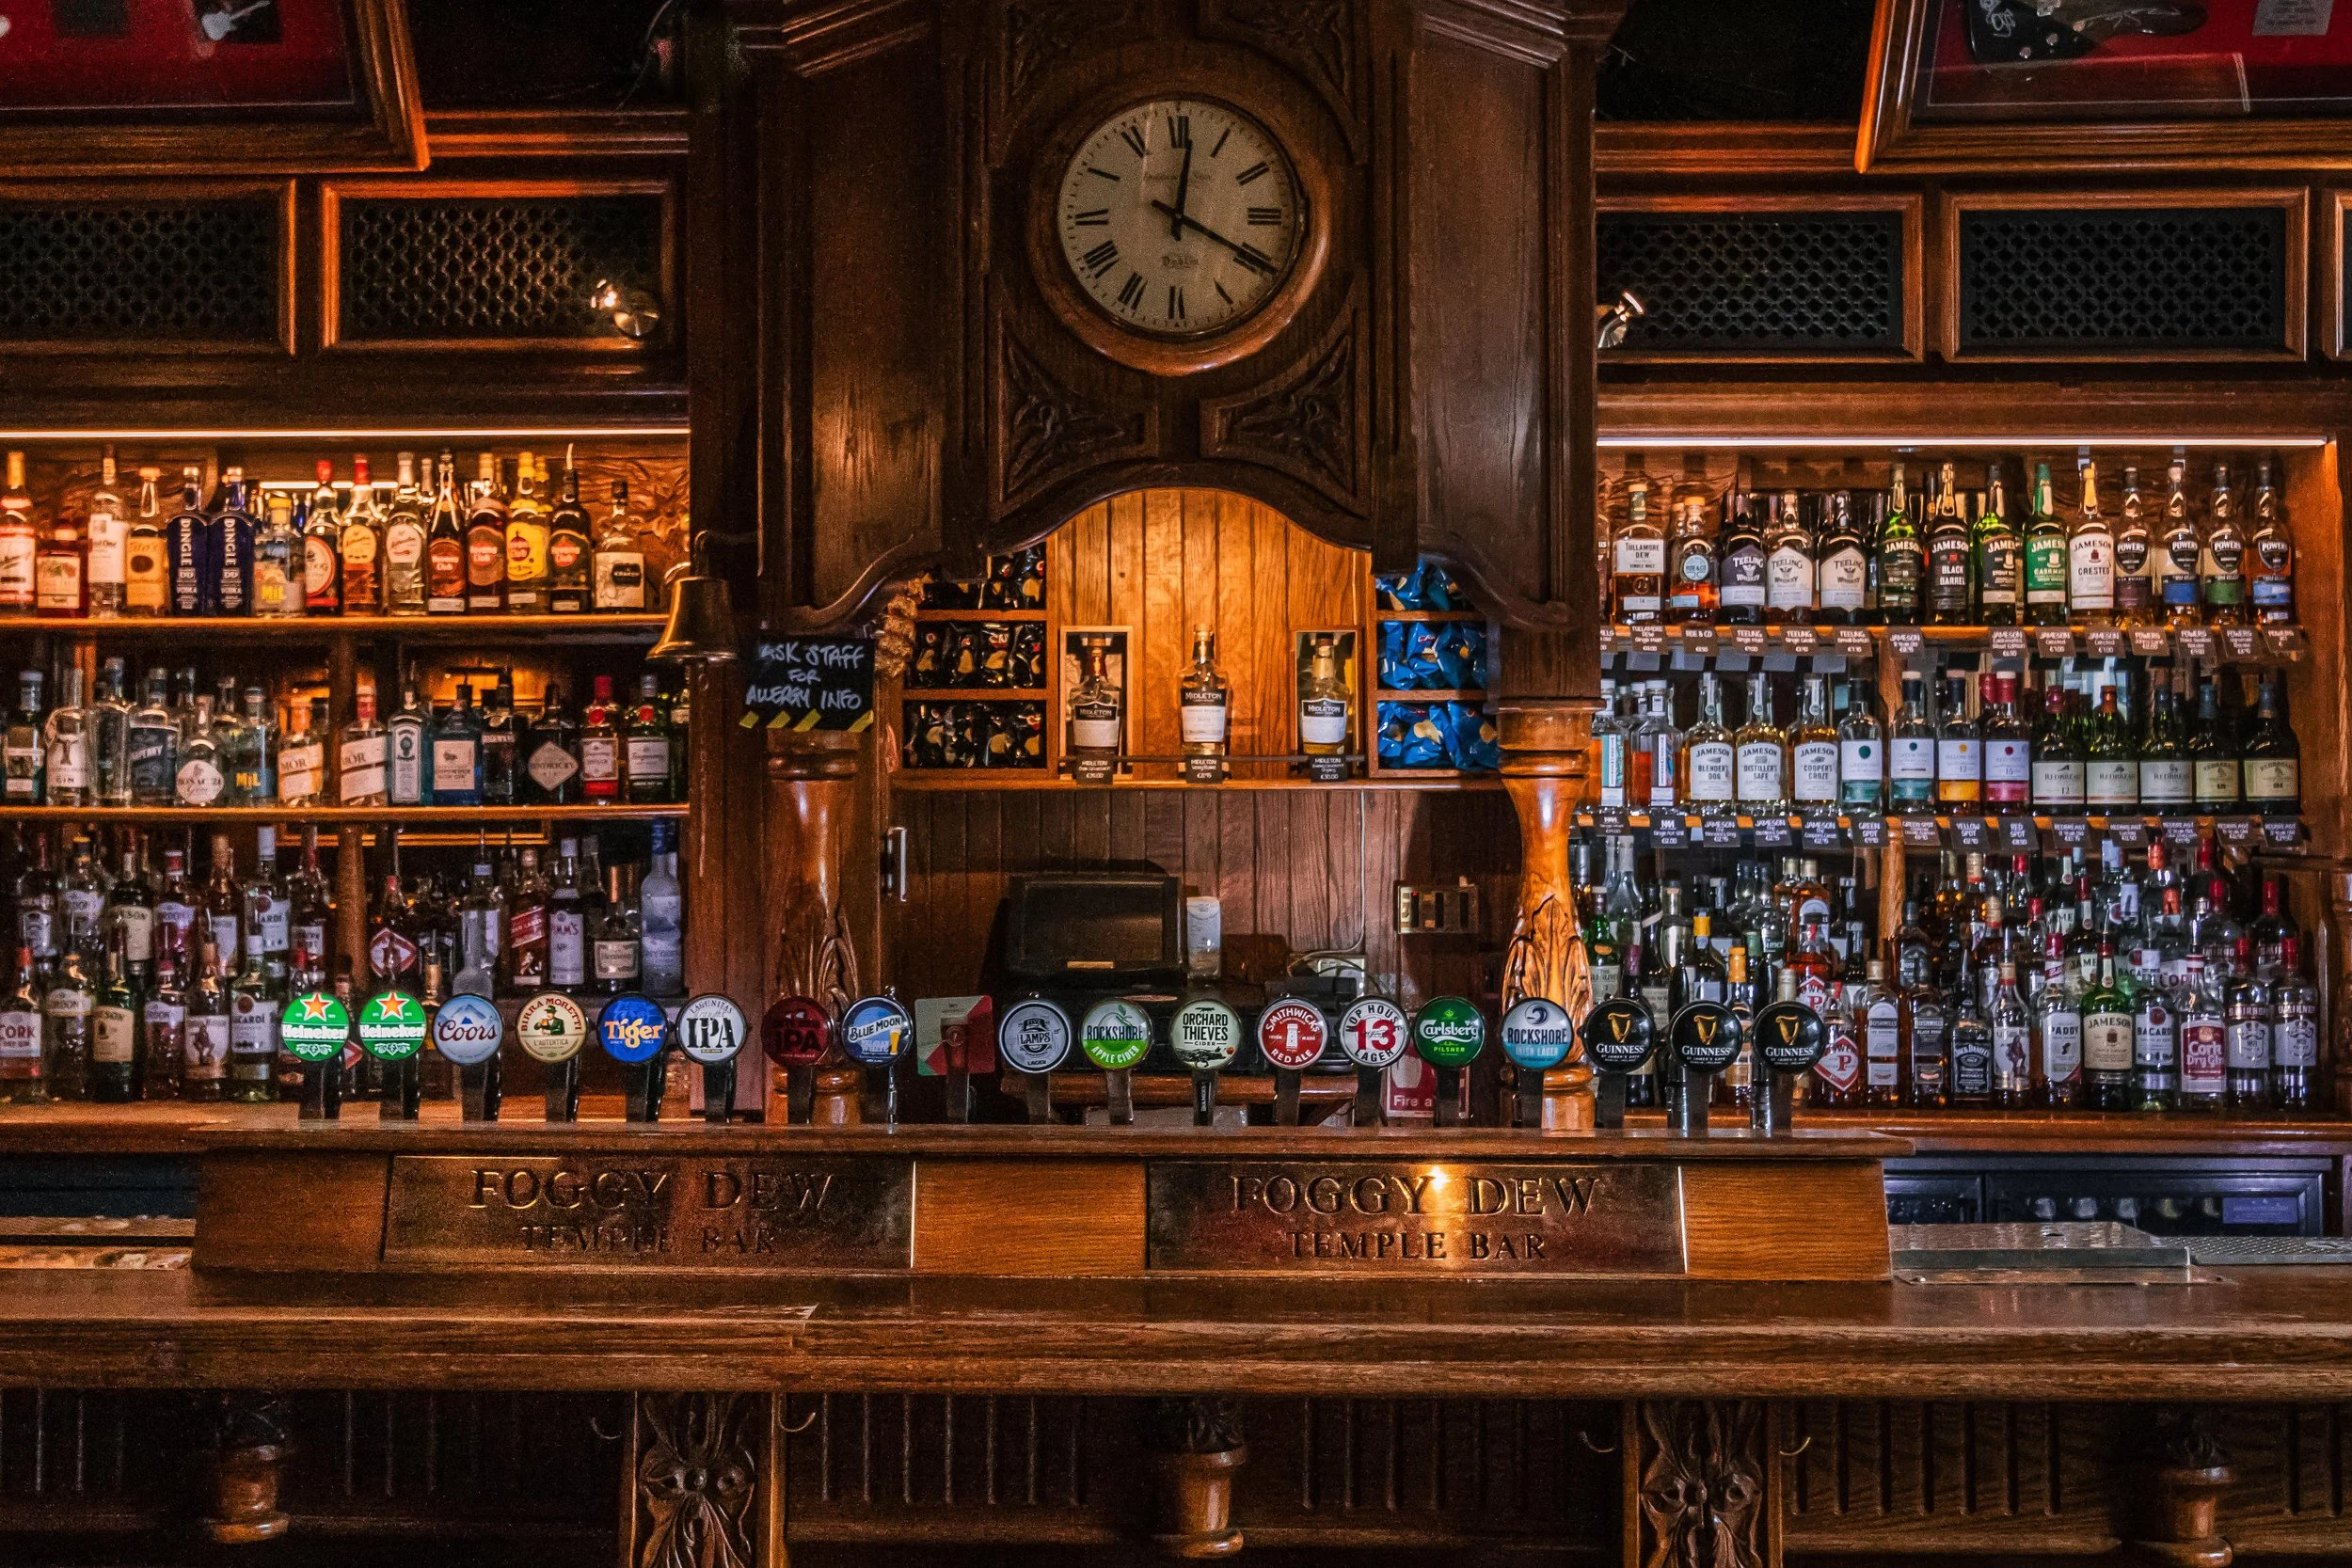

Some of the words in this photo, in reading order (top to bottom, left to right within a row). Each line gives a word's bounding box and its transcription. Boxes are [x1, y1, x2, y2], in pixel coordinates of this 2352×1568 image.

[181, 518, 192, 566] DINGLE
[224, 518, 236, 566] DINGLE
[1625, 543, 1660, 551] TULLAMORE
[2118, 543, 2145, 552] POWERS
[2215, 541, 2241, 550] POWERS
[2262, 542, 2288, 551] POWERS
[1733, 557, 1764, 568] TEELING
[1772, 560, 1803, 570] TEELING
[1834, 559, 1864, 570] TEELING
[759, 641, 799, 661] ASK
[805, 644, 865, 669] STAFF
[787, 670, 821, 683] FOR
[820, 690, 862, 709] INFO
[1185, 691, 1222, 700] MIDLETON
[1696, 747, 1730, 757] JAMESON
[1742, 748, 1777, 756] JAMESON
[1801, 748, 1835, 756] JAMESON
[690, 999, 732, 1014] LAGUNITAS
[521, 1000, 544, 1032] BIRRA
[546, 998, 581, 1030] MORETTI
[1183, 1013, 1229, 1026] ORCHARD
[1345, 1009, 1362, 1032] HOP
[1368, 1005, 1403, 1031] HOUSE
[282, 1024, 347, 1039] Heineken
[359, 1024, 425, 1039] Heineken
[438, 1020, 498, 1041] Coors
[850, 1022, 875, 1040] BLUE
[876, 1017, 900, 1032] MOON
[1420, 1020, 1479, 1040] Carlsberg
[2089, 1019, 2131, 1029] JAMESON
[605, 1018, 664, 1049] Tiger
[687, 1018, 737, 1048] IPA
[1021, 1033, 1050, 1044] LAMPS
[1087, 1025, 1143, 1041] ROCKSHORE
[1183, 1026, 1229, 1041] THIEVES
[1355, 1019, 1396, 1051] 13
[1508, 1028, 1567, 1045] ROCKSHORE
[1091, 1046, 1115, 1063] APPLE
[1117, 1045, 1139, 1063] CIDER
[1596, 1043, 1645, 1054] GUINNESS
[1682, 1045, 1731, 1056] GUINNESS
[1765, 1046, 1814, 1057] GUINNESS
[2188, 1041, 2221, 1054] Cork
[1271, 1049, 1292, 1062] RED
[1295, 1050, 1313, 1063] ALE
[1355, 1049, 1394, 1062] LAGER
[1837, 1055, 1851, 1070] P
[2186, 1055, 2207, 1068] Dry
[1393, 1096, 1418, 1107] Fire
[470, 1170, 668, 1211] FOGGY
[702, 1171, 832, 1212] DEW
[1232, 1175, 1430, 1216] FOGGY
[1470, 1177, 1600, 1217] DEW
[522, 1226, 670, 1253] TEMPLE
[701, 1227, 776, 1253] BAR
[1286, 1231, 1447, 1259] TEMPLE
[1470, 1232, 1546, 1259] BAR
